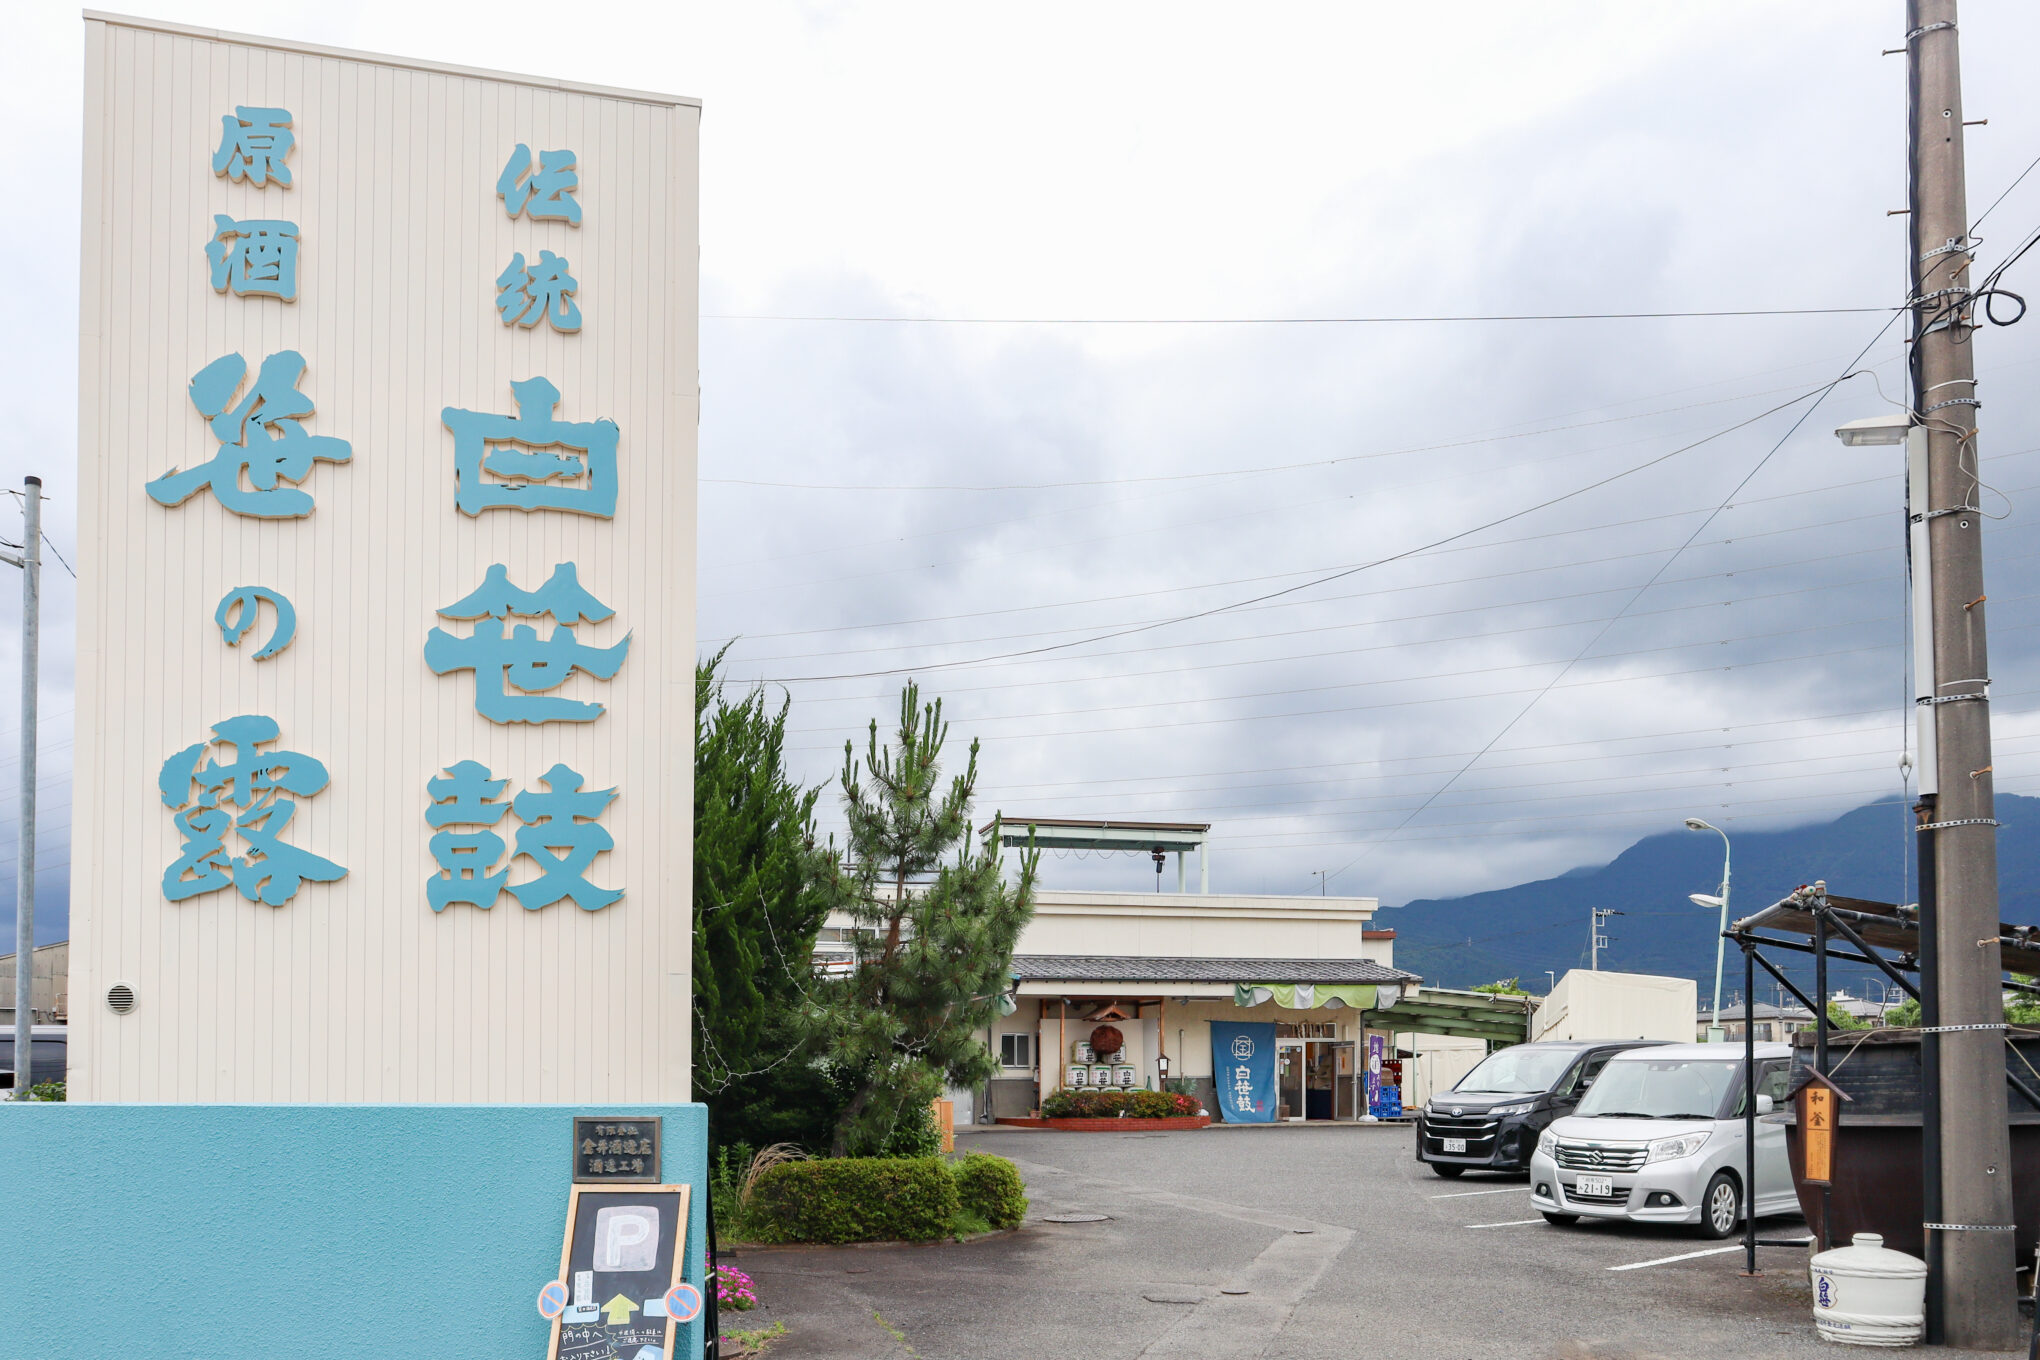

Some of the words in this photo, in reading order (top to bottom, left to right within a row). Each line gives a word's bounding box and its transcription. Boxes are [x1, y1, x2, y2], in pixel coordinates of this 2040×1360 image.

[205, 106, 299, 303] 原酒
[496, 143, 582, 334] 伝統
[145, 350, 353, 907] 笹の露
[424, 376, 632, 912] 白笹鼓
[1234, 1064, 1256, 1114] 白笹鼓
[1810, 1090, 1825, 1127] 和釜
[581, 1137, 652, 1155] 金井酒造店
[595, 1124, 639, 1136] 有限会社
[588, 1158, 644, 1174] 酒造工場
[606, 1214, 651, 1267] P
[562, 1327, 603, 1345] 門の中へ
